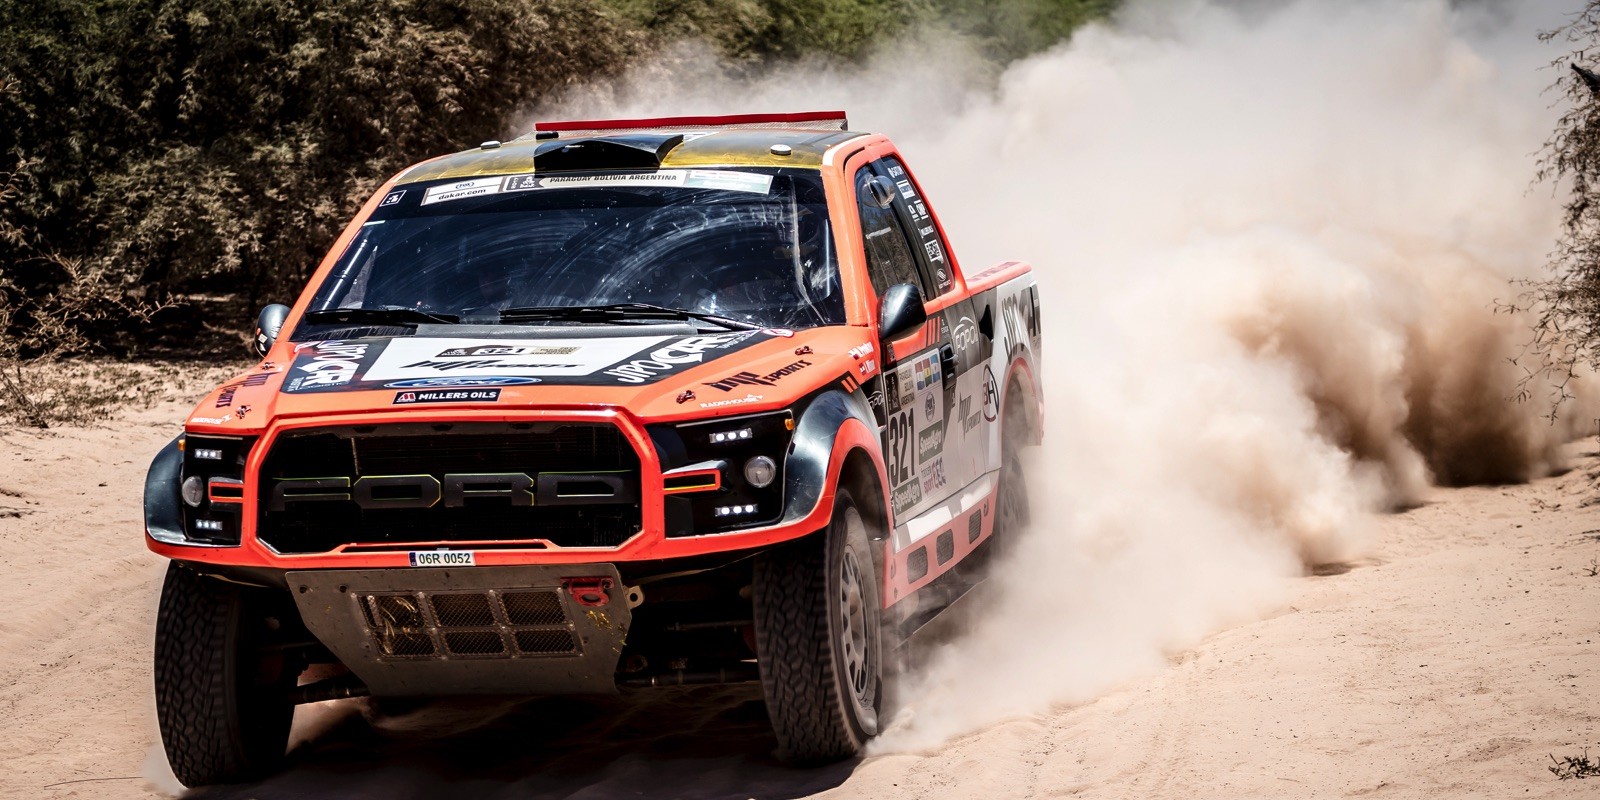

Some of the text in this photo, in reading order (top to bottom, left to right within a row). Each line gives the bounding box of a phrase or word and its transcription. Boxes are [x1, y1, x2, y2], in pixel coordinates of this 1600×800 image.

[438, 188, 486, 200] dakar.com
[762, 360, 812, 382] SPORTS
[418, 392, 468, 400] MILLERS
[889, 407, 915, 488] 321
[271, 470, 637, 511] FORD
[418, 552, 471, 564] 06R 0052
